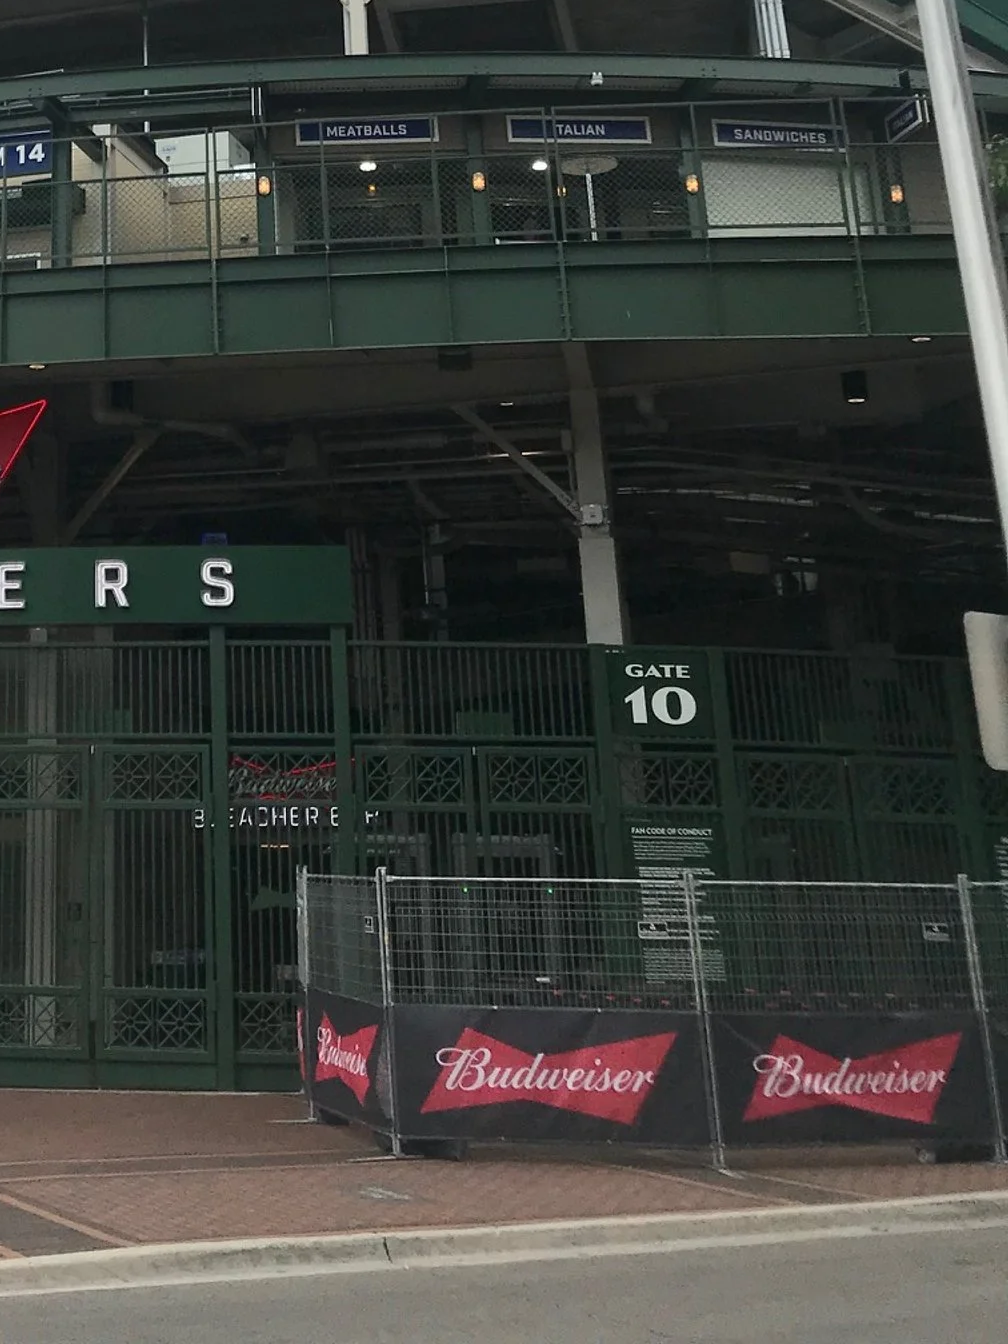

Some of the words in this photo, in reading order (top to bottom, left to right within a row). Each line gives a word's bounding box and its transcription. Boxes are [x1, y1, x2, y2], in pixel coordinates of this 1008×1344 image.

[326, 123, 407, 137] MEATBALLS
[555, 123, 606, 136] TALIAN
[733, 128, 827, 144] SANDWICHES
[16, 142, 46, 165] 14
[625, 663, 691, 679] GATE
[624, 685, 697, 725] 10
[228, 766, 338, 794] Budweise
[631, 827, 645, 835] FAN
[646, 827, 666, 835] CODE
[677, 828, 712, 836] CONDUCT
[436, 1046, 655, 1093] Budweiser
[753, 1055, 948, 1098] Budweiser
